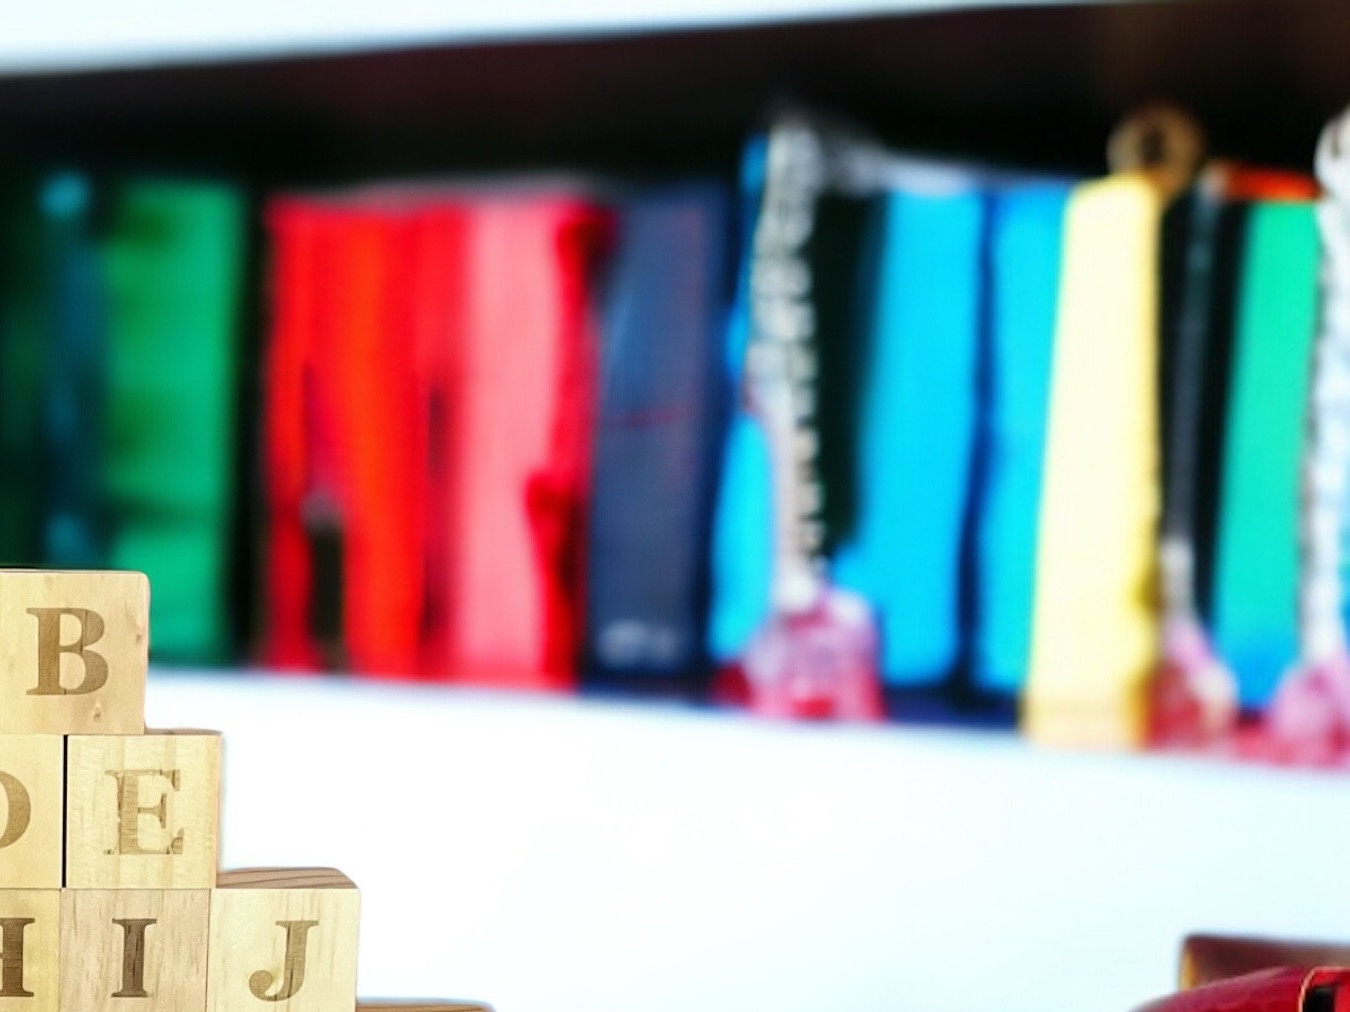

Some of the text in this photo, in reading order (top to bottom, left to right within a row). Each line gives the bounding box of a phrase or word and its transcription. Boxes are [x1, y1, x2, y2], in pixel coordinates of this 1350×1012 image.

[26, 606, 110, 696] B
[104, 769, 185, 856] E
[111, 918, 157, 998] I
[248, 920, 320, 1002] J
